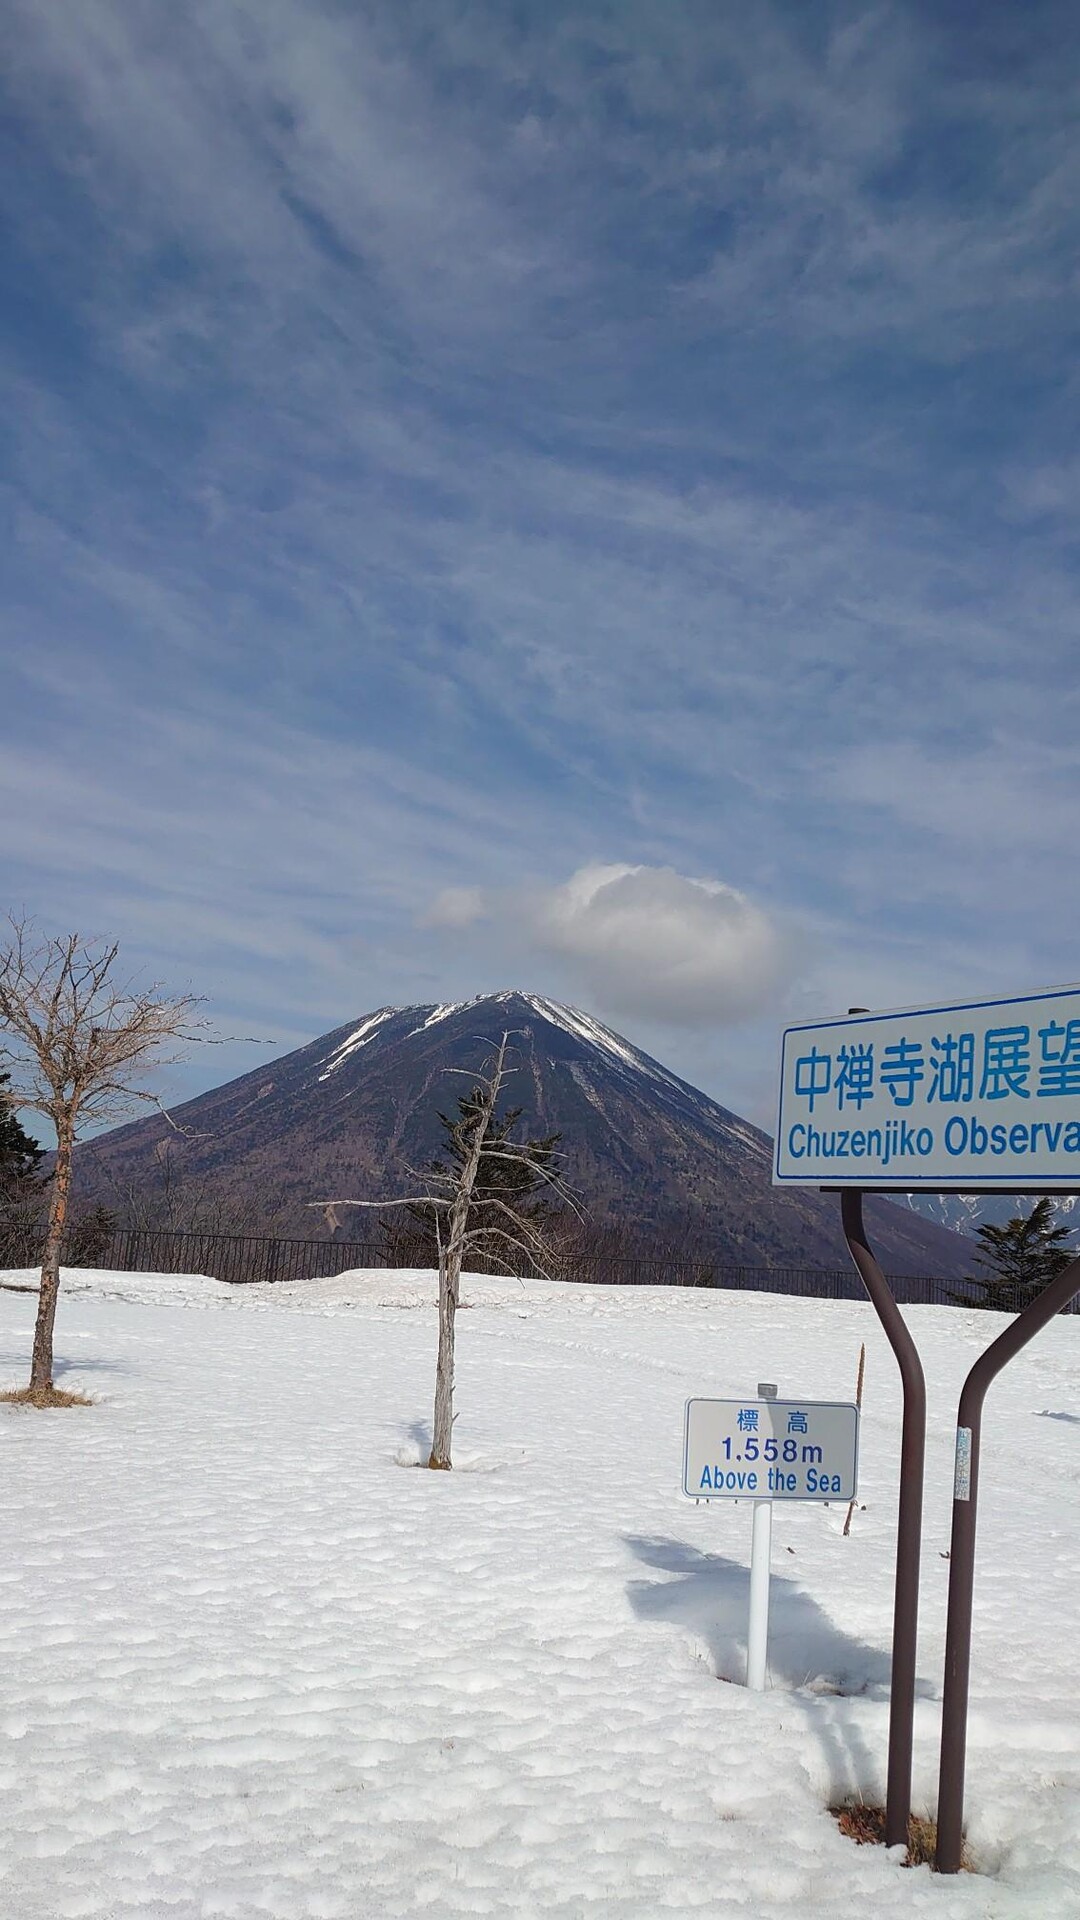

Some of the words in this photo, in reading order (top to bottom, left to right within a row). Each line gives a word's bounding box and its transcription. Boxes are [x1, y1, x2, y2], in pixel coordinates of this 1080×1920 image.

[794, 1019, 1080, 1113] 中禅寺湖展望
[788, 1120, 933, 1165] Chuzenjiko
[944, 1115, 1080, 1156] Observa
[700, 1464, 757, 1490] Above
[767, 1467, 796, 1491] the
[806, 1467, 841, 1493] Sea
